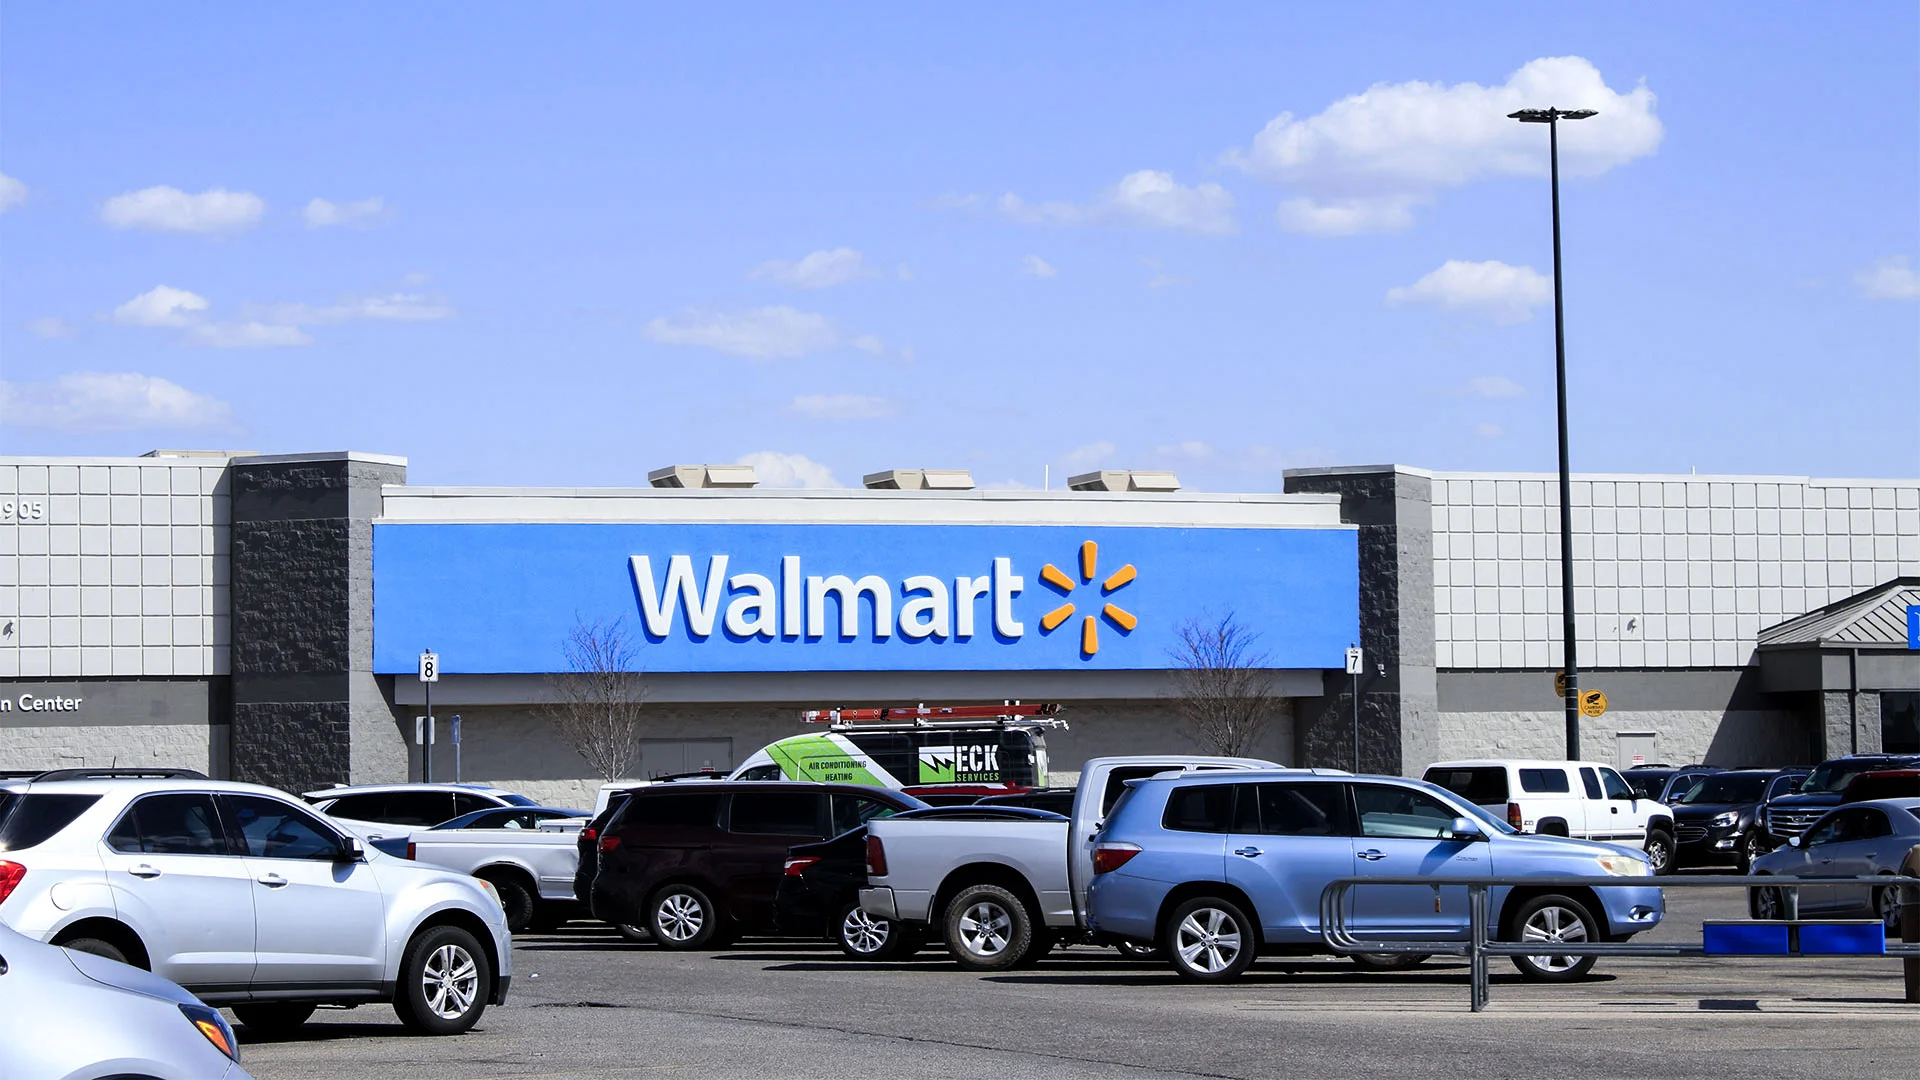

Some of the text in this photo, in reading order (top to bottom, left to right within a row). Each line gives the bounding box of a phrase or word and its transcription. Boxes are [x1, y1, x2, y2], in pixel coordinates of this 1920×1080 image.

[628, 554, 1024, 638] Walmart
[424, 661, 434, 678] 8
[1350, 655, 1359, 670] 7
[0, 693, 83, 712] n Center
[808, 760, 867, 770] AIR CONDITIONING
[956, 745, 1000, 772] ECK
[825, 772, 853, 782] HEATING
[956, 772, 1000, 782] SERVICES
